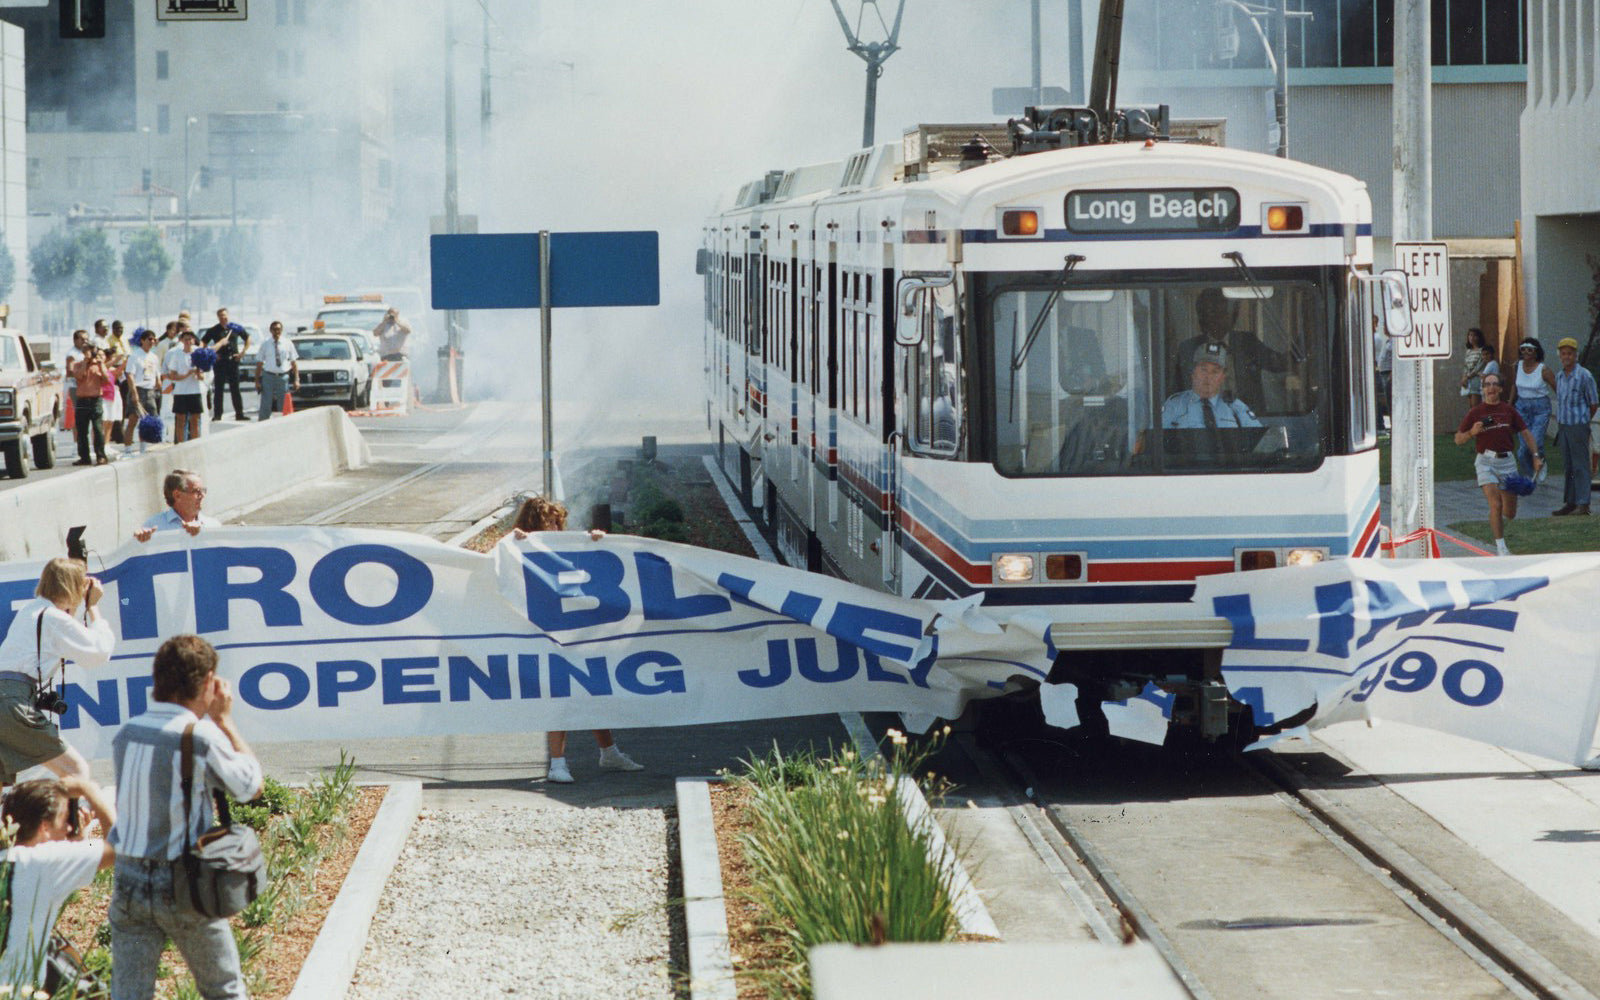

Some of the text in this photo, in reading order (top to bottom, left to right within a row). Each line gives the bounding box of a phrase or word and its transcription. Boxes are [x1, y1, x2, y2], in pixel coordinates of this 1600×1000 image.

[1074, 193, 1228, 224] Long Beach
[1403, 252, 1441, 276] LEFT
[1410, 287, 1442, 312] URN
[239, 651, 686, 710] OPENING
